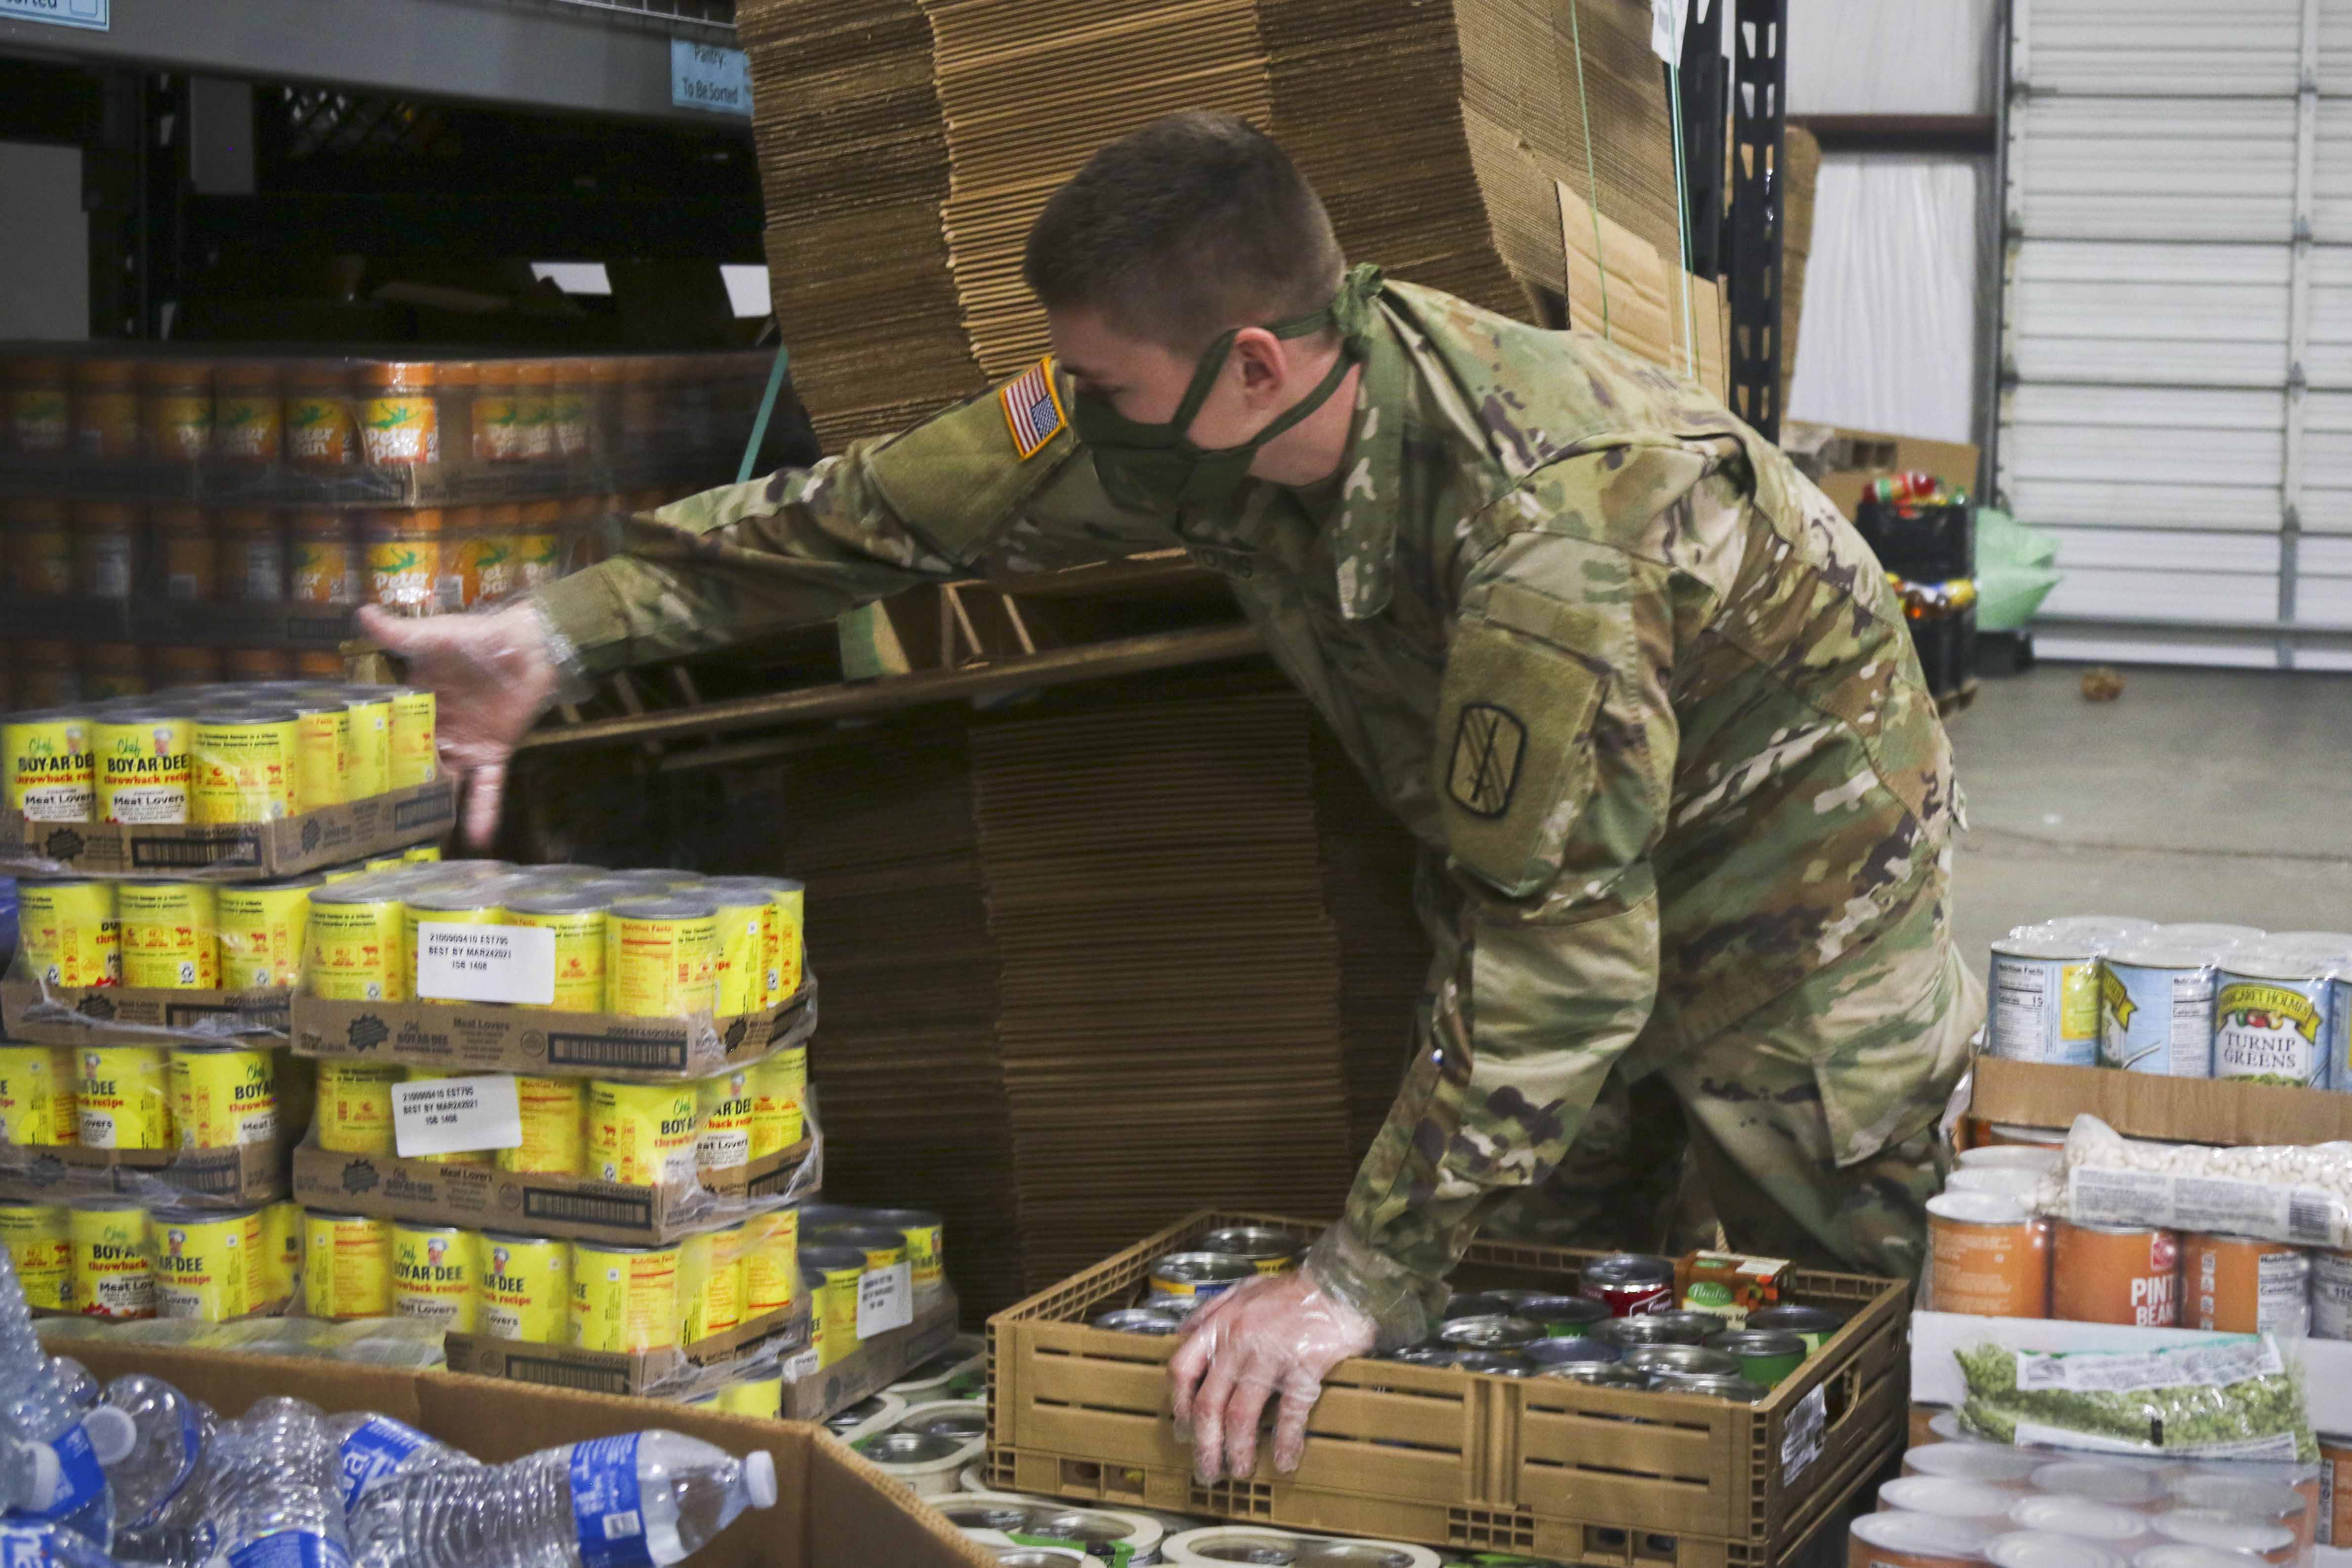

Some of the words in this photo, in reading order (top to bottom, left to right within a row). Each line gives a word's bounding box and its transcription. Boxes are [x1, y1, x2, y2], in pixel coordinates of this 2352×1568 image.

[25, 795, 54, 805] Meat
[114, 795, 141, 805] Meat
[147, 794, 185, 805] Lovers
[428, 946, 449, 955] BEST
[453, 947, 463, 956] BY
[2225, 1031, 2296, 1052] TURNIP
[2224, 1048, 2297, 1068] GREENS
[403, 1105, 420, 1115] BEST
[423, 1104, 433, 1113] BY
[2131, 1274, 2174, 1307] PINT
[2136, 1303, 2174, 1327] BEAN
